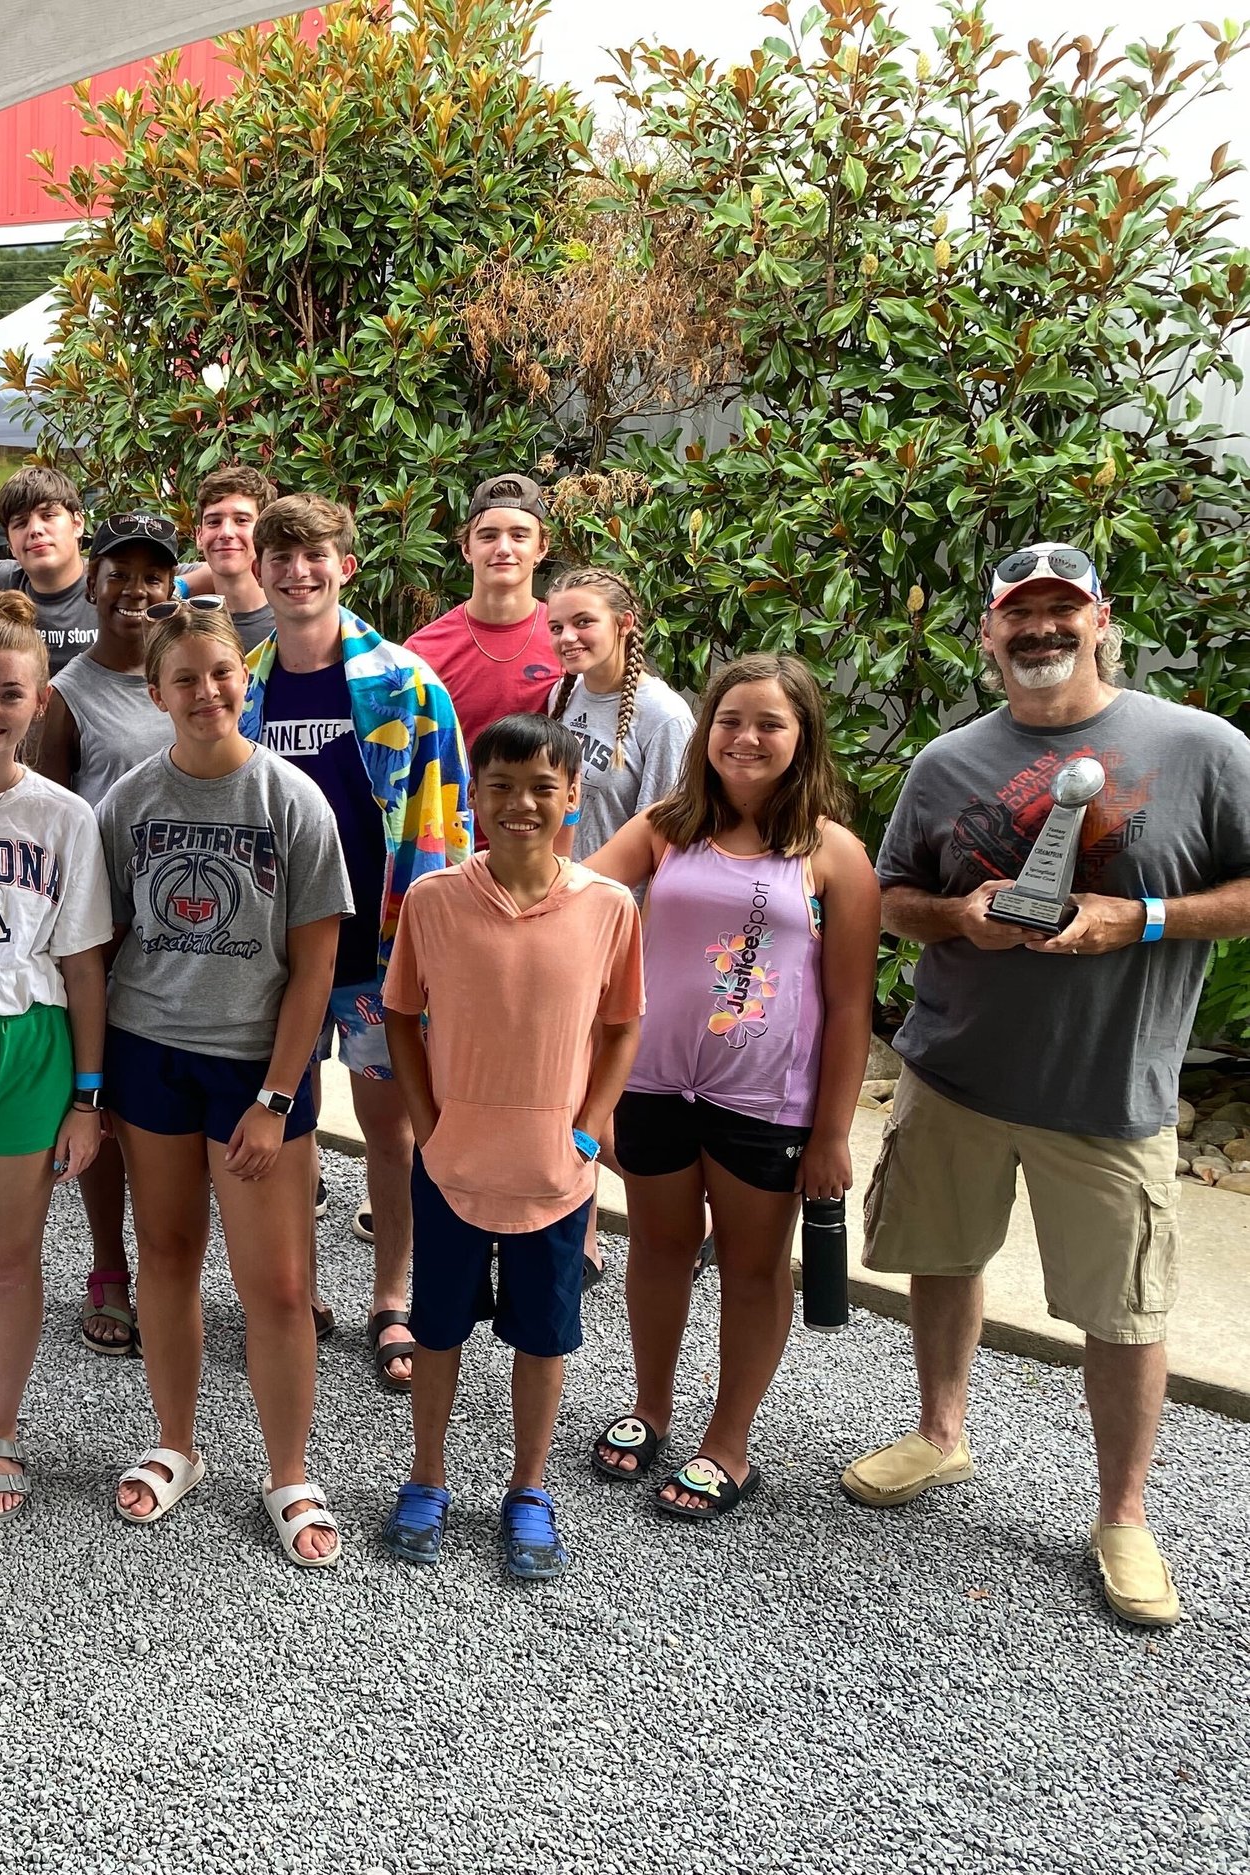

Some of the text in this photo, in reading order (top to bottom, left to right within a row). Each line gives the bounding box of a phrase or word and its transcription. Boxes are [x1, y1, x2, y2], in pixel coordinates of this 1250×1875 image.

[48, 630, 65, 648] my
[67, 627, 99, 646] story
[262, 723, 341, 752] NNESSEE
[570, 721, 588, 730] adidas
[210, 930, 263, 959] Camp
